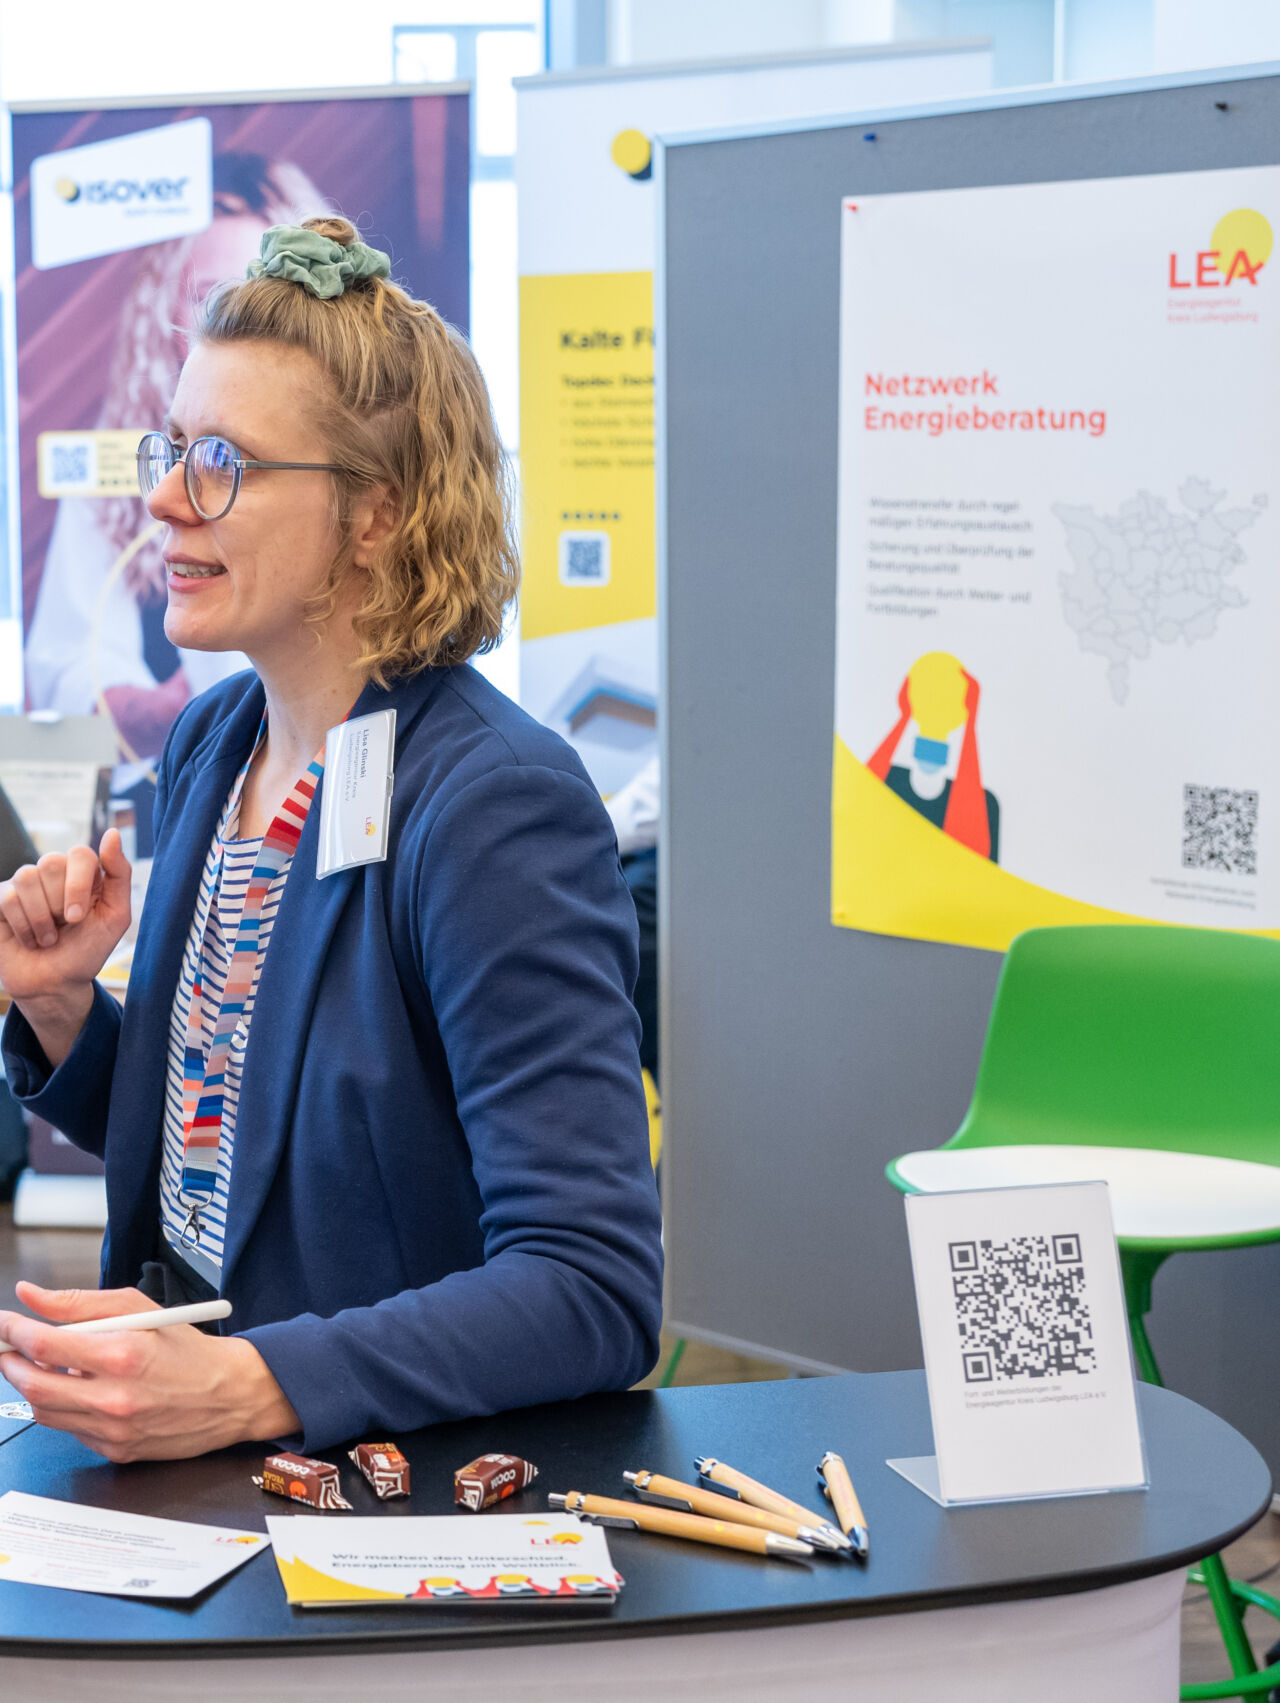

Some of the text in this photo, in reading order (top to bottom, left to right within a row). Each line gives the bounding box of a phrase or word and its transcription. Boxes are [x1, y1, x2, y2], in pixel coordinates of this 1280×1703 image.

[1168, 248, 1264, 289] LEA
[864, 370, 999, 397] Netzwerk
[863, 402, 1107, 438] Energieberatung
[272, 1457, 310, 1475] COCOA
